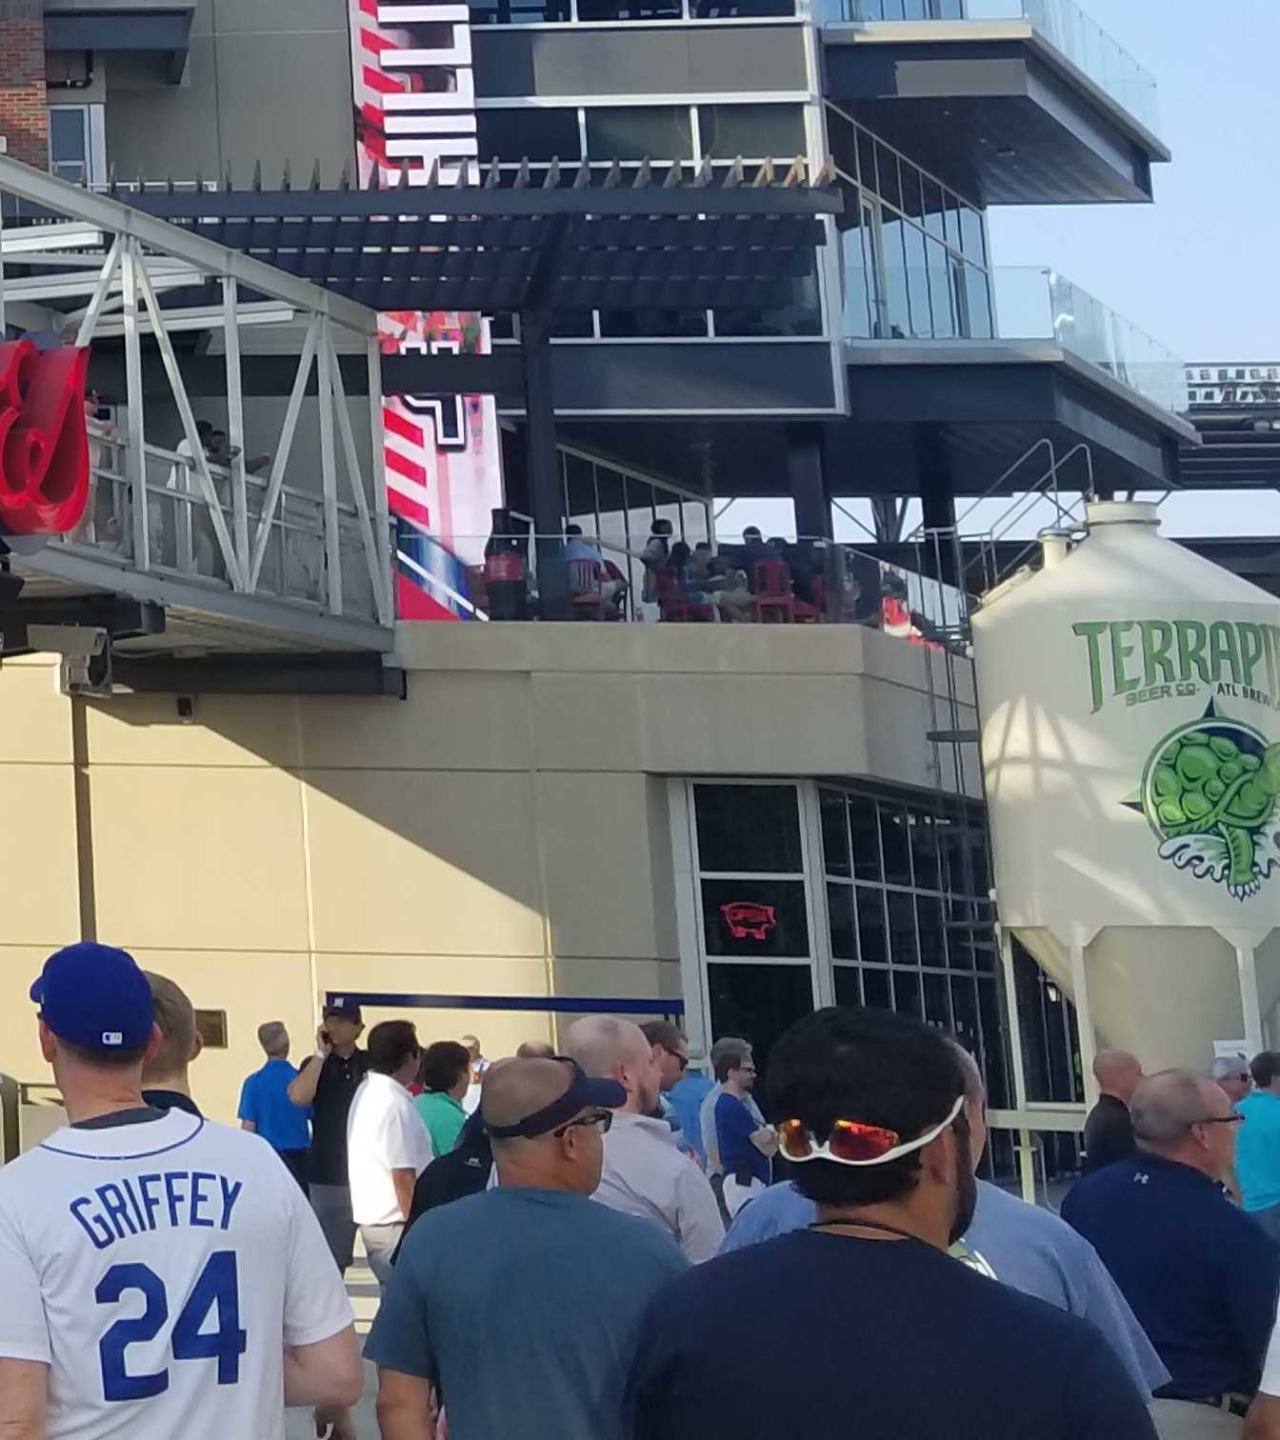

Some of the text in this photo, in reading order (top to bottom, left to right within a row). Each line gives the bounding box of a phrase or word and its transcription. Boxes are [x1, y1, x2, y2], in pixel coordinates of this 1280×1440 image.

[1125, 684, 1173, 707] BEER
[1216, 682, 1238, 698] ATL
[69, 1170, 243, 1250] GRIFFEY
[94, 1249, 248, 1403] 24
